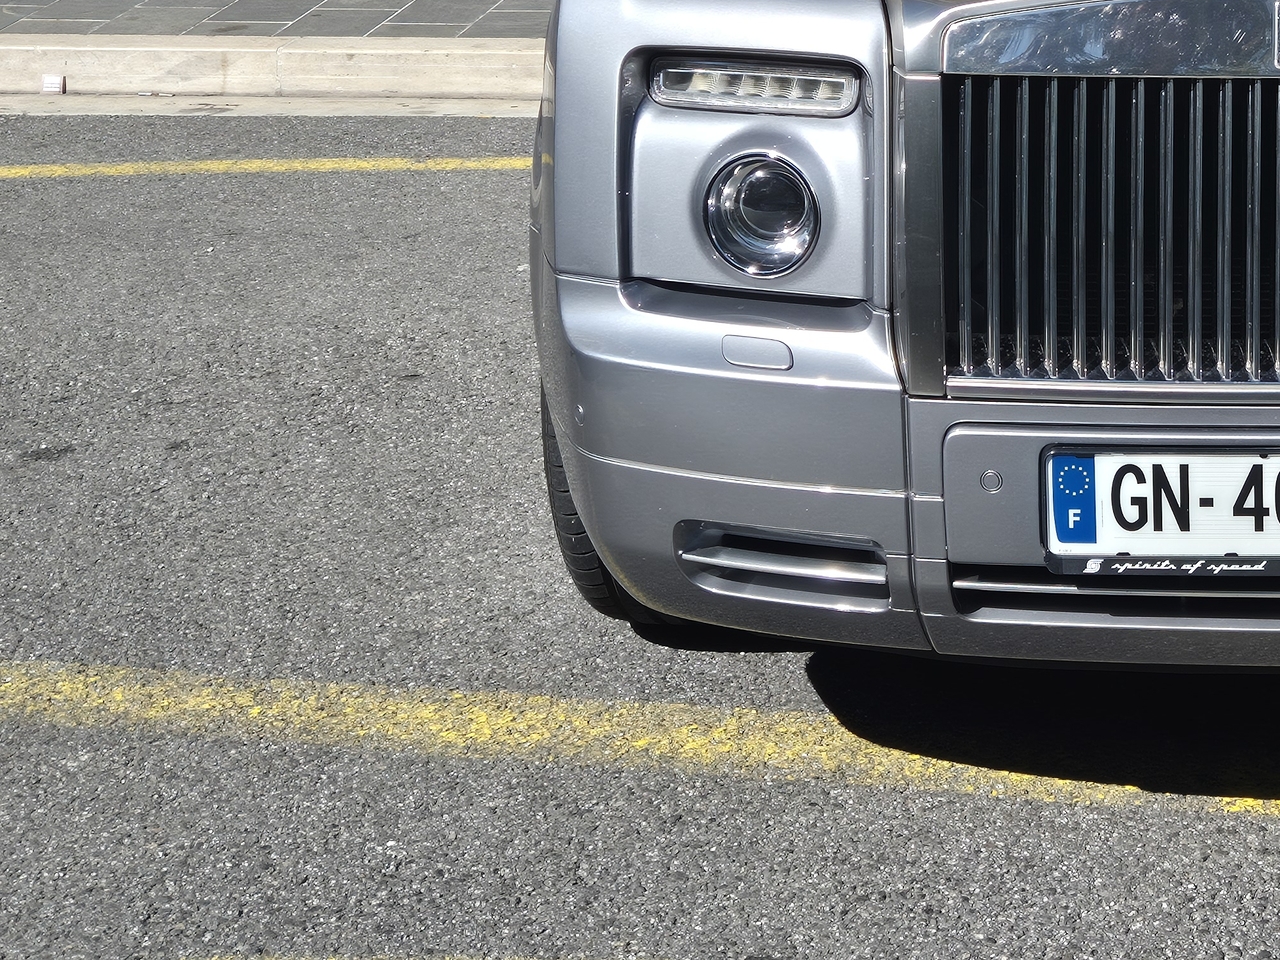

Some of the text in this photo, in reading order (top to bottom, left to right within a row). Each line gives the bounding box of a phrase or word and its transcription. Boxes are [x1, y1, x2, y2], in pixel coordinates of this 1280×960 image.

[1067, 509, 1082, 529] F
[1111, 558, 1268, 574] spirits of speed
